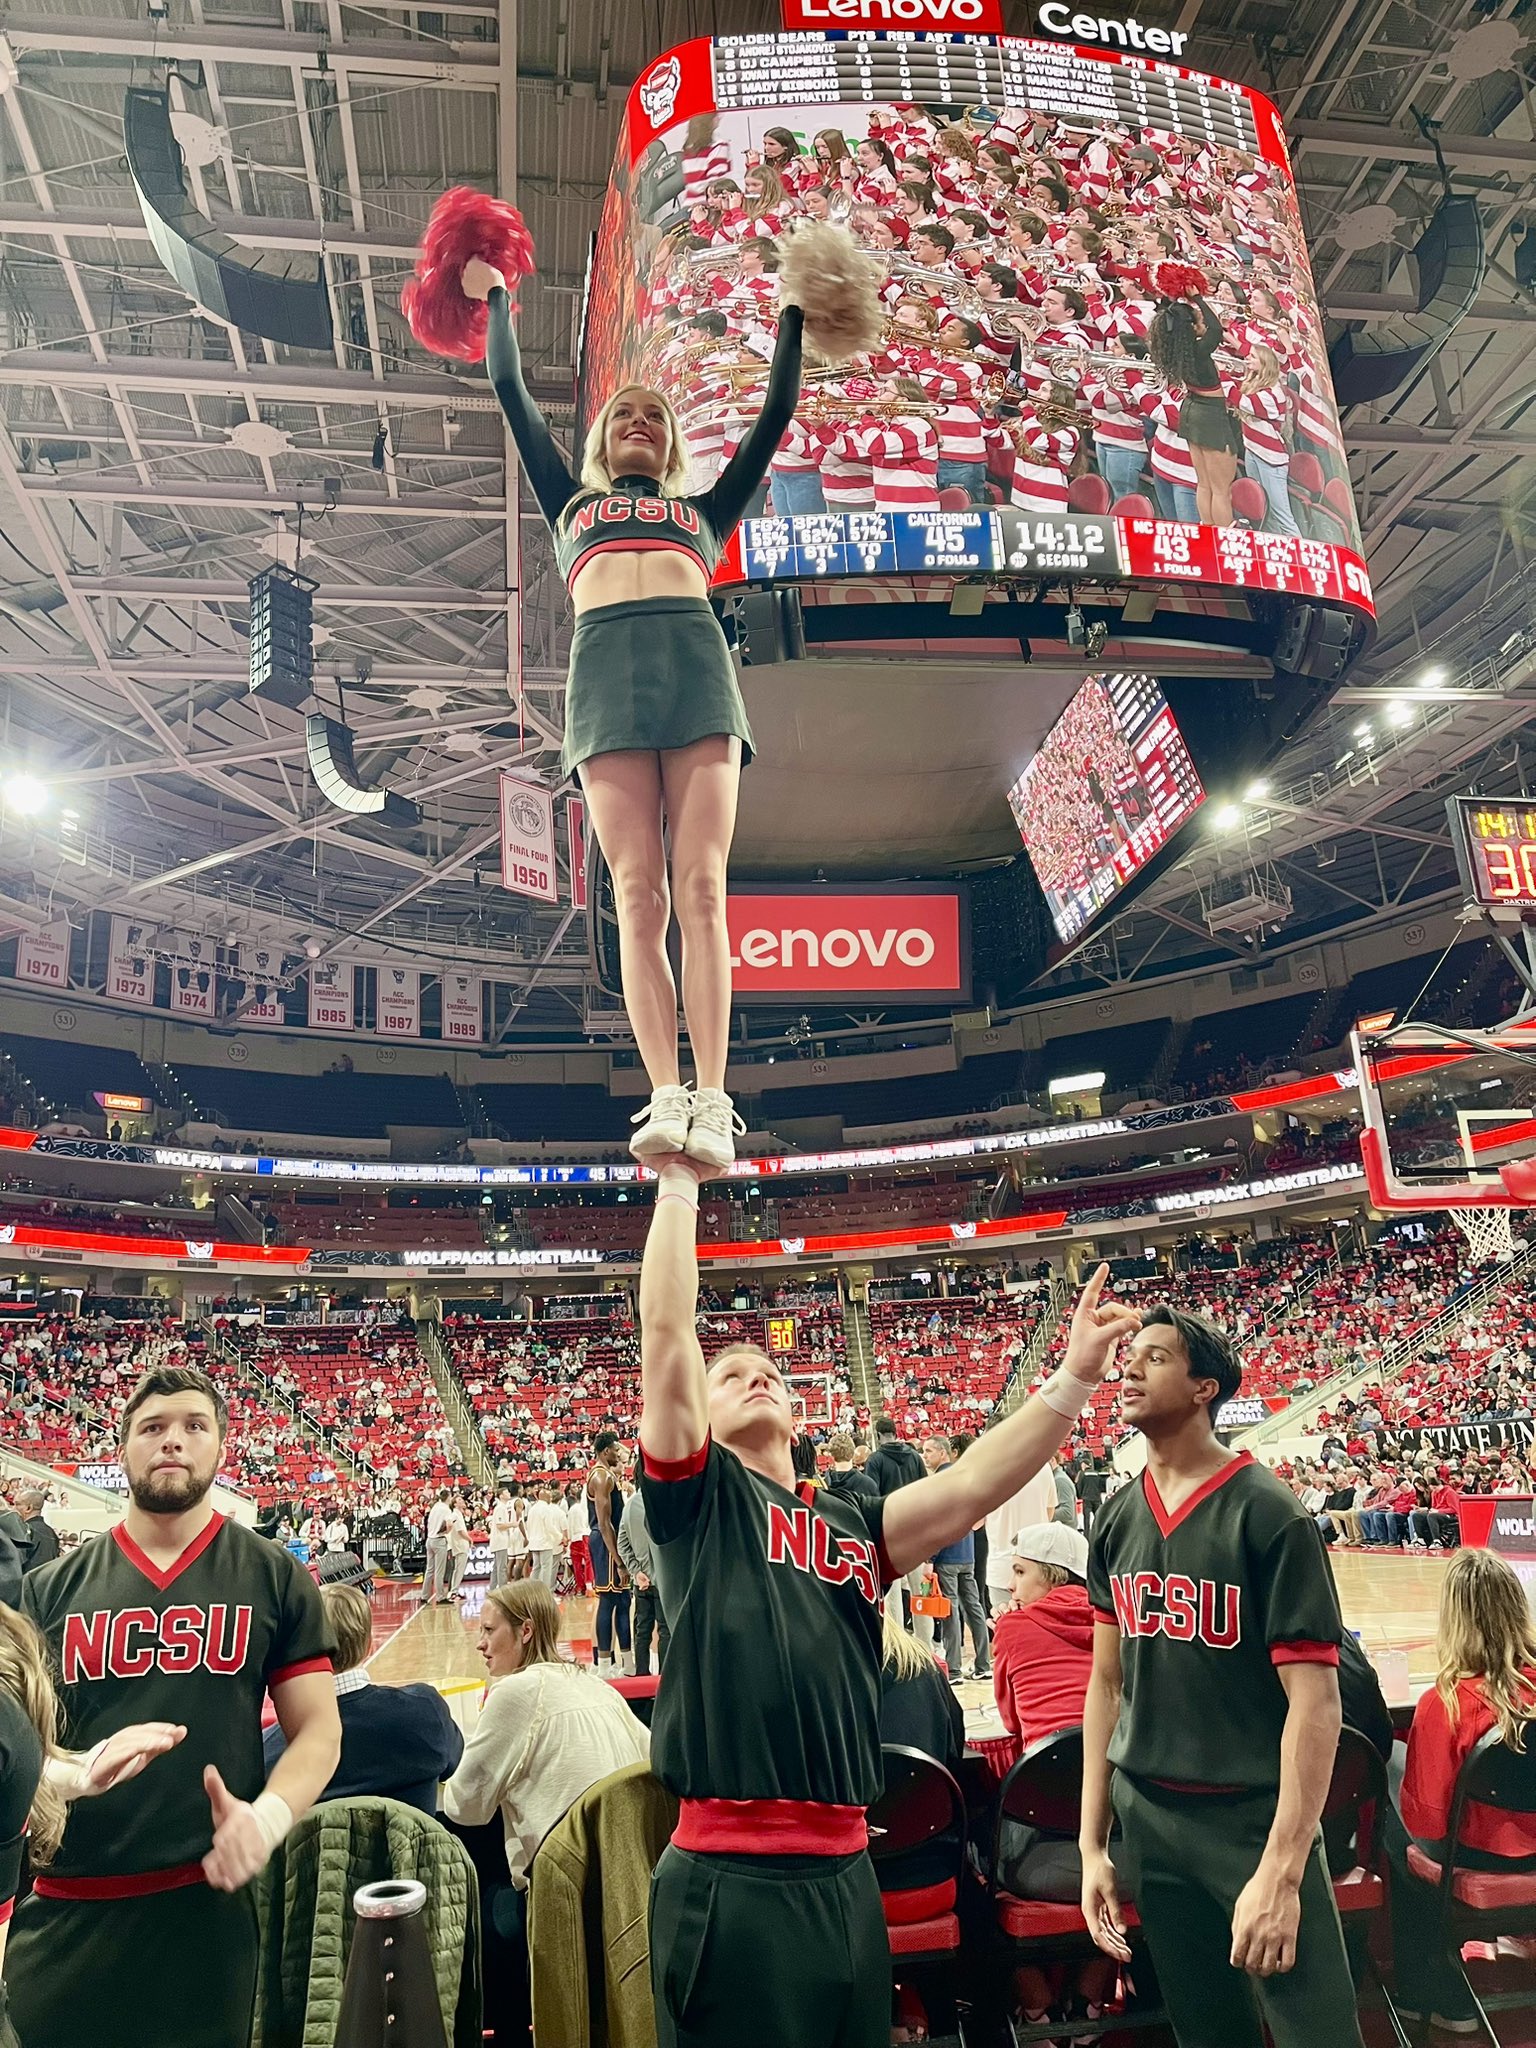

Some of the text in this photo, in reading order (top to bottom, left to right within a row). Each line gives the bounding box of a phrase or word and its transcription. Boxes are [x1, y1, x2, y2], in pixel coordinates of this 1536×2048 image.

[718, 30, 990, 47] GOLDEN BEARS PTS REB AST FLS
[1038, 2, 1188, 57] Center
[935, 44, 946, 55] 0
[975, 46, 984, 57] 1
[740, 58, 757, 70] DJ
[760, 55, 838, 68] CAMPBELL
[855, 54, 874, 65] 11
[899, 54, 908, 65] 1
[937, 56, 948, 67] 0
[975, 58, 986, 69] 0
[1001, 38, 1076, 57] WOLFPACK
[1121, 55, 1146, 70] PTS
[1188, 71, 1211, 86] AST
[718, 72, 737, 83] 10
[899, 66, 910, 77] 0
[718, 84, 737, 95] 12
[741, 81, 779, 94] MADY
[939, 80, 951, 91] 0
[979, 82, 988, 93] 1
[1004, 72, 1148, 103] 10 MARCUS HILL 11
[1024, 63, 1069, 79] JAYDEN
[1069, 69, 1114, 86] TAYLOR
[1200, 96, 1210, 107] 0
[1231, 105, 1241, 116] 0
[1131, 68, 1141, 80] 0
[1197, 85, 1207, 96] 0
[1229, 94, 1238, 105] 1
[742, 94, 778, 106] RYTIS
[862, 90, 874, 101] 0
[981, 94, 990, 105] 1
[1171, 110, 1181, 122] 1
[1204, 119, 1214, 130] 0
[1237, 128, 1245, 140] 1
[1206, 130, 1216, 142] 0
[572, 496, 700, 543] NCSU
[750, 513, 887, 533] FG% 3PT% FT%
[908, 513, 982, 527] CALIFORNIA
[751, 525, 888, 547] 55% 62% 57%
[925, 526, 965, 551] 45
[1016, 522, 1105, 553] 14:12
[1133, 520, 1200, 539] NC STATE
[1154, 535, 1190, 562] 43
[1217, 527, 1328, 556] FG% 3PT% FT%
[753, 543, 881, 564] AST STL TO
[937, 554, 979, 566] FOULS
[1037, 554, 1089, 568] SECOND
[766, 560, 777, 578] 7
[816, 558, 827, 574] 3
[1153, 562, 1202, 576] 1 FOULS
[1223, 555, 1327, 583] AST STL TO
[1235, 570, 1324, 596] 3 5 5
[1478, 812, 1536, 839] 14:1
[509, 843, 549, 864] FINAL FOUR
[512, 863, 548, 891] 1950
[24, 936, 65, 952] CHAMPIONS
[1405, 929, 1424, 942] 337
[26, 958, 60, 979] 1970
[1300, 968, 1317, 981] 336
[115, 977, 146, 997] 1973
[314, 988, 350, 999] CHAMPIONS
[178, 991, 207, 1010] 1974
[381, 996, 415, 1006] CHAMPIONS
[446, 1002, 478, 1013] CHAMPIONS
[56, 1015, 73, 1026] 331
[316, 1008, 346, 1023] 1985
[384, 1015, 413, 1030] 1987
[1362, 1017, 1392, 1030] Lenovo
[449, 1022, 476, 1036] 1989
[107, 1096, 139, 1107] Lenovo
[1028, 1119, 1128, 1146] BASKETBALL
[1156, 1162, 1365, 1212] WOLFPACK BASKETBALL
[404, 1249, 602, 1265] WOLFPACK BASKETBALL
[771, 1331, 793, 1349] 30
[1420, 1425, 1492, 1456] STATE
[916, 1599, 922, 1610] G
[1109, 1571, 1240, 1649] NCSU
[62, 1604, 252, 1684] NCSU
